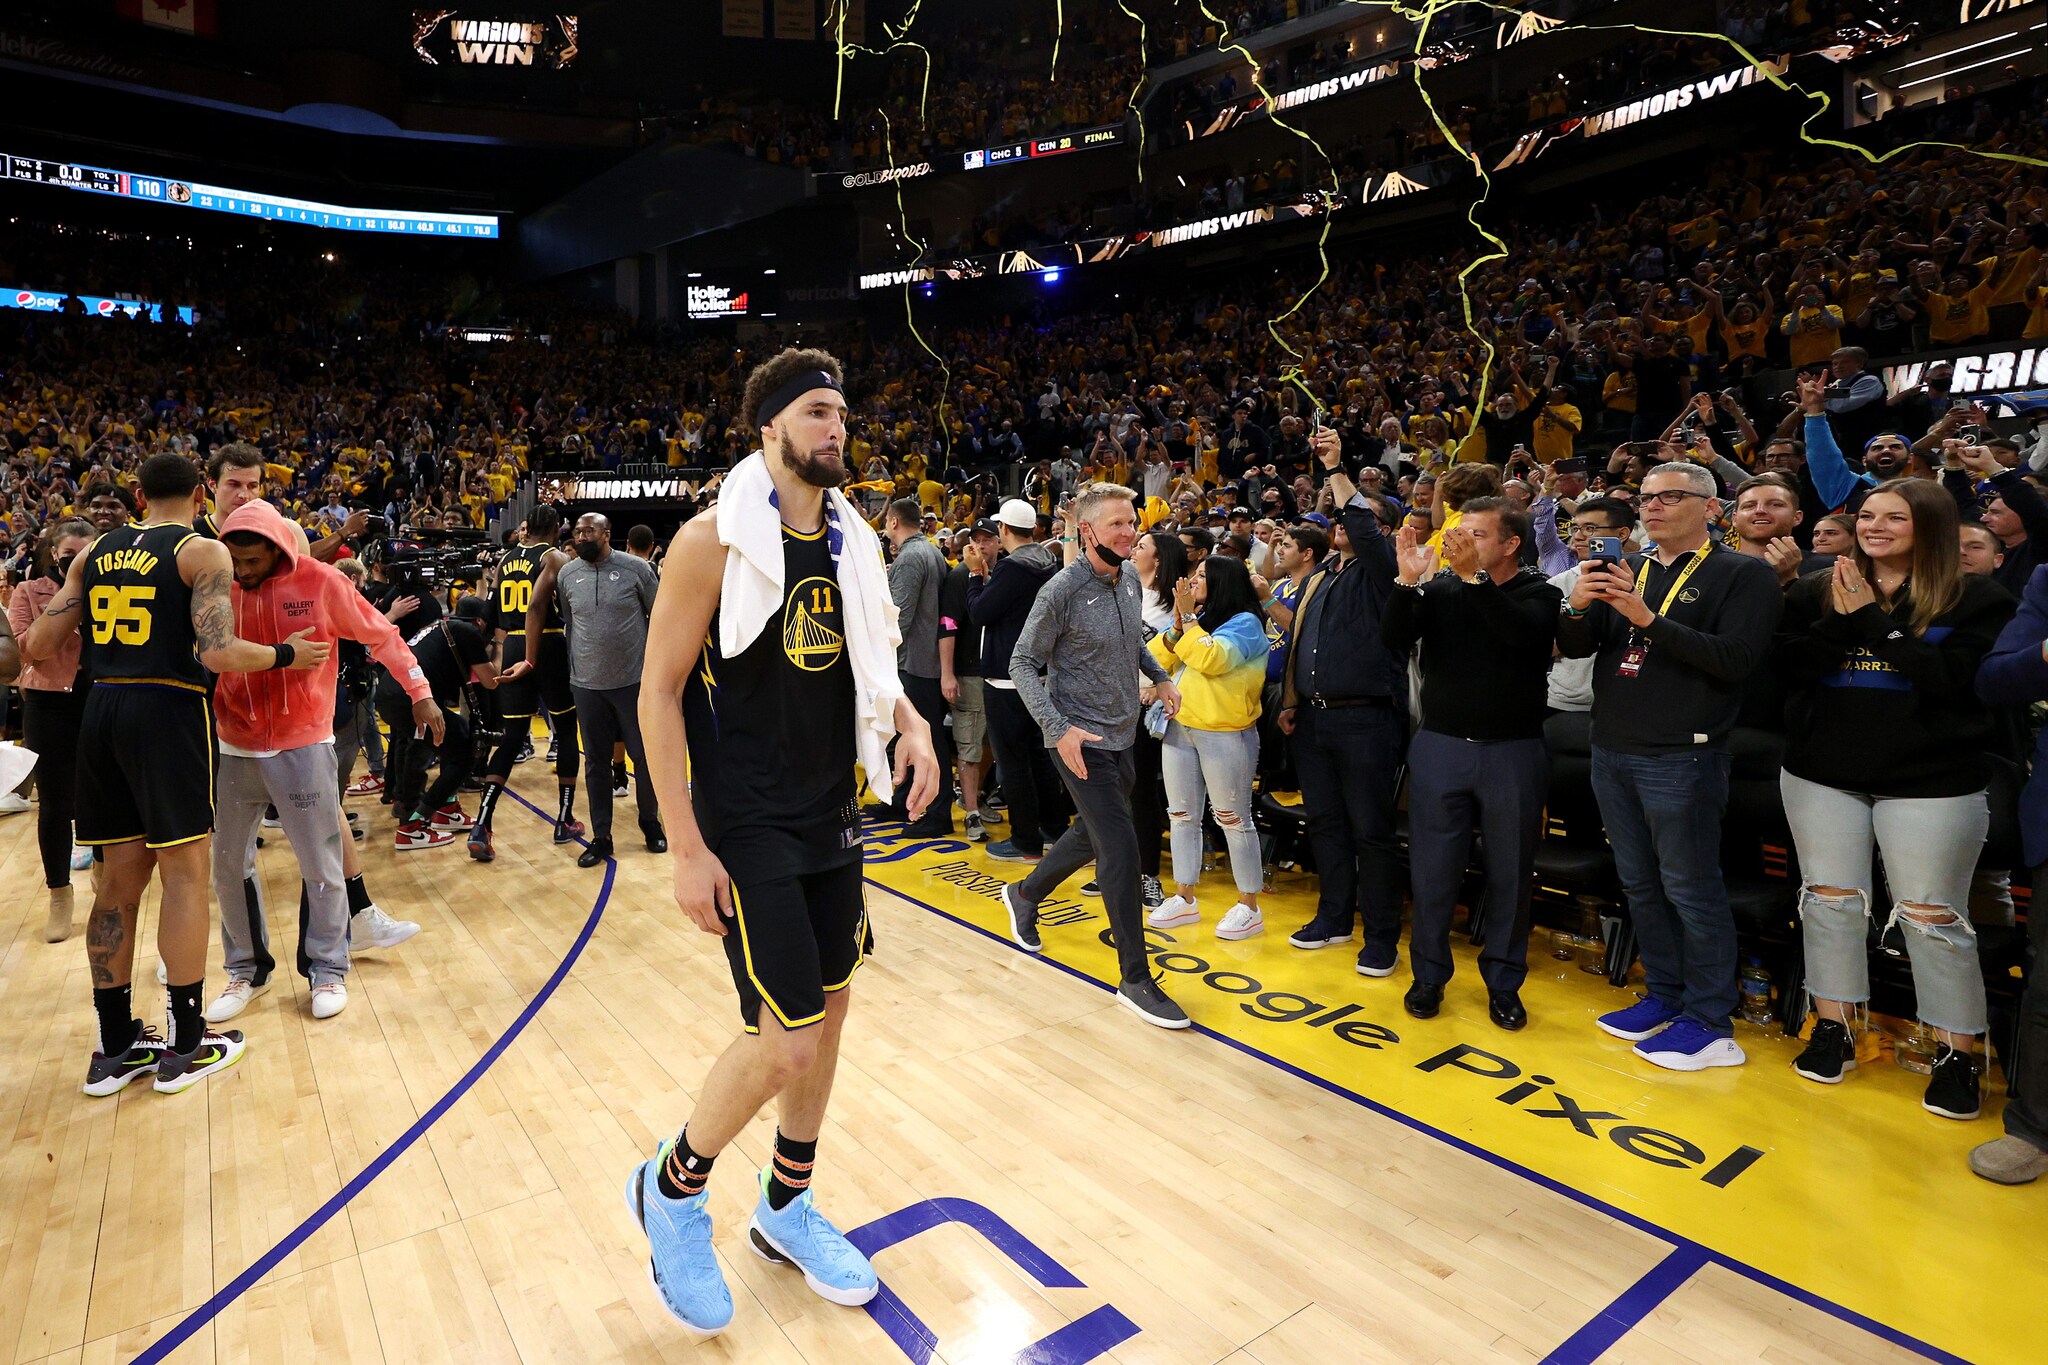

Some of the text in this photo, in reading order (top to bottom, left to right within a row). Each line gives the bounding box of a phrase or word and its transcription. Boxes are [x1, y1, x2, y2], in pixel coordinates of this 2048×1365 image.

[451, 20, 544, 44] WARRIORS
[457, 42, 533, 65] WIN
[1265, 60, 1399, 114] WARRIORS WIN
[1584, 53, 1790, 138] WARRIORS WIN
[991, 131, 1115, 159] CHC 5 CIN 20 FINAL
[15, 159, 42, 171] TOL 2
[15, 170, 31, 179] FLS
[59, 165, 82, 181] 0.0
[61, 179, 92, 189] QUARTER
[93, 171, 109, 180] TOL
[94, 182, 109, 191] FLS
[113, 184, 119, 193] 3
[137, 180, 160, 197] 110
[200, 196, 212, 206] 22
[300, 211, 306, 220] 4
[324, 215, 329, 224] 7
[346, 218, 351, 227] 7
[365, 219, 376, 229] 32
[1152, 204, 1274, 247] WARRIORS WIN
[892, 267, 934, 284] WIN
[688, 285, 730, 299] Holler
[688, 298, 732, 311] Moller
[1883, 348, 2048, 400] WRRI
[564, 480, 699, 499] WARRIORS WIN
[95, 549, 158, 575] TOSCANO
[283, 600, 315, 610] GALLERY
[501, 580, 532, 613] 00
[811, 587, 834, 614] 11
[89, 585, 156, 646] 95
[287, 609, 311, 617] DEPT.
[289, 791, 321, 801] GALLERY
[1099, 927, 1766, 1189] Google Pixel
